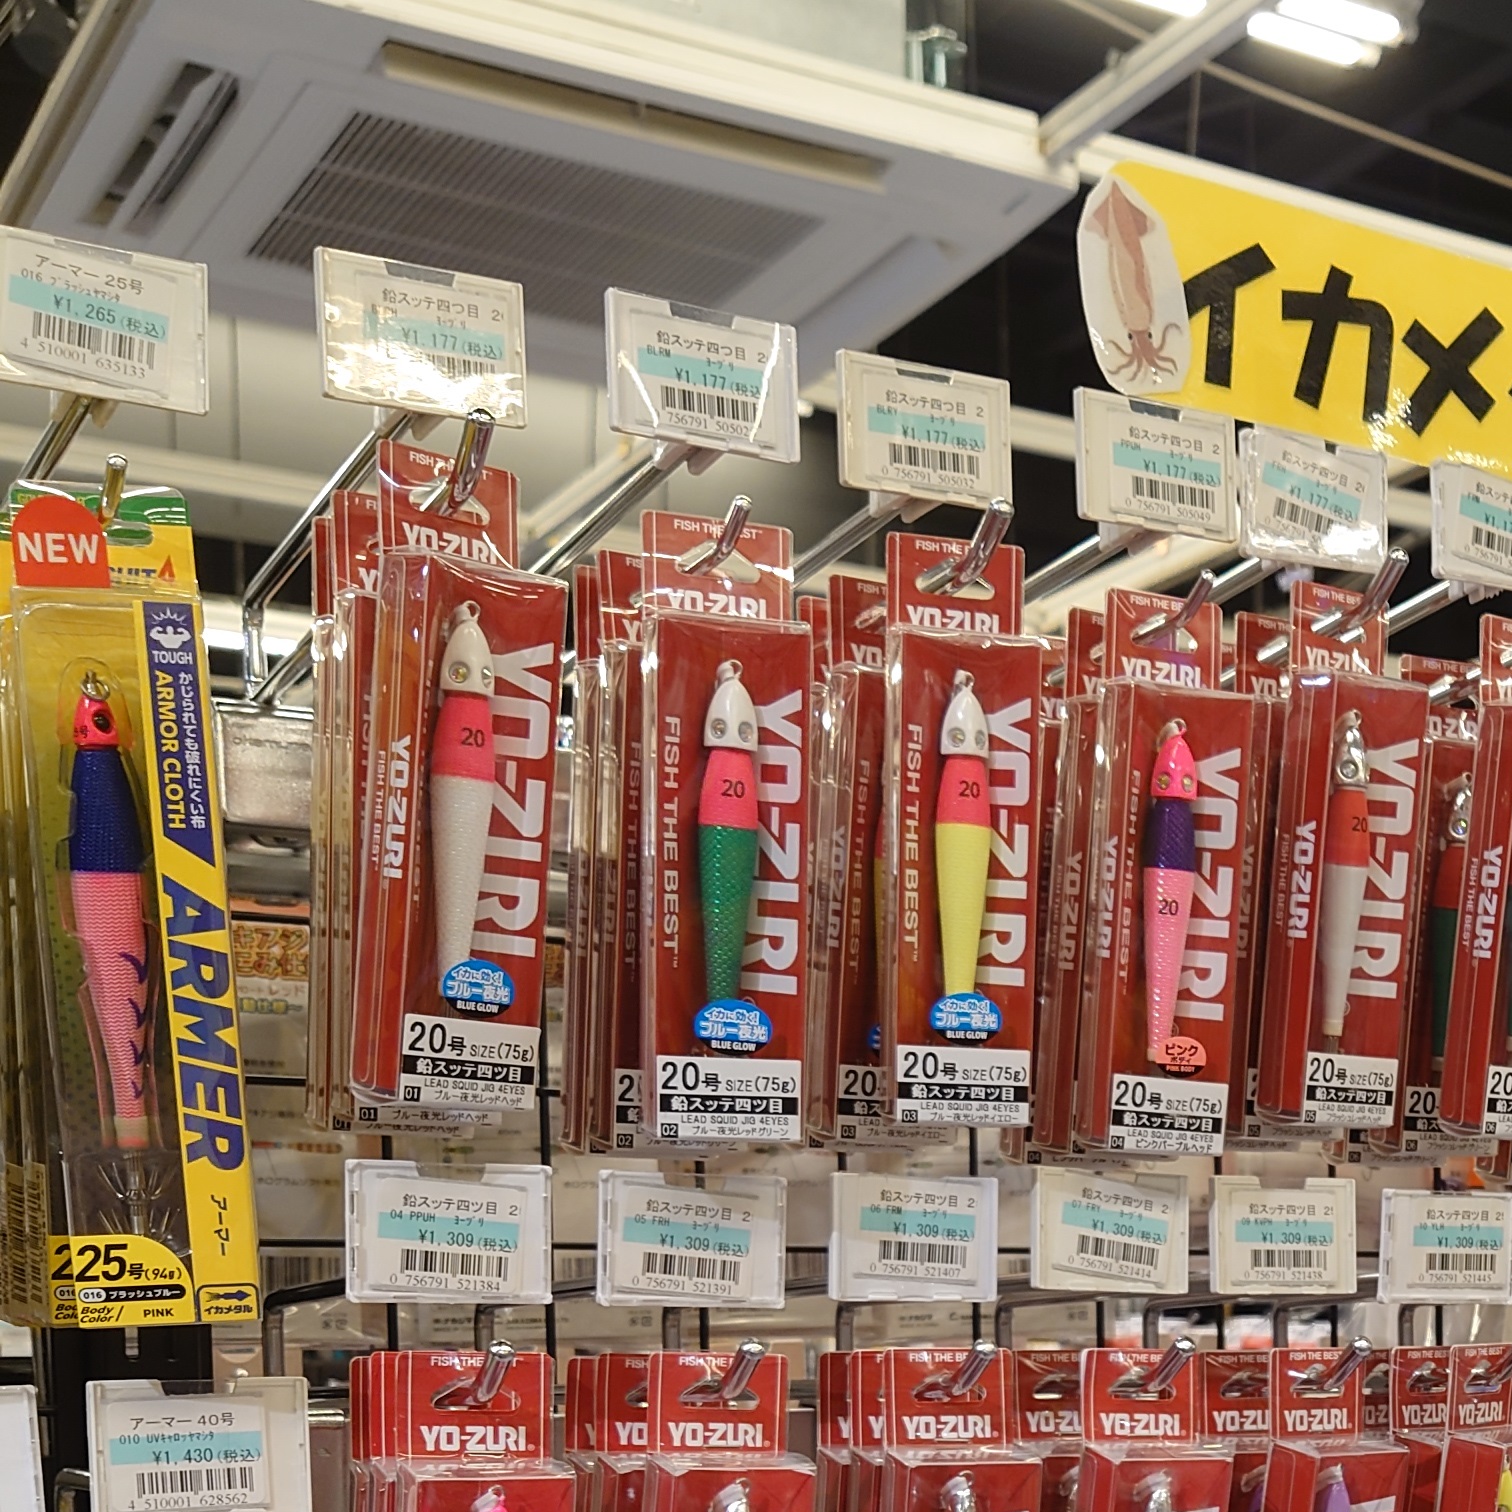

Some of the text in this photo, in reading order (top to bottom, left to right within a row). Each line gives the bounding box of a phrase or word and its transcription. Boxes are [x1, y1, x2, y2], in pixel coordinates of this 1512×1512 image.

[34, 252, 144, 296] アーマー 25号
[381, 287, 480, 320] 鉛スッテ四つ目
[20, 338, 147, 379] 4 510001 635133
[885, 389, 967, 416] 鉛スッテ四つ目
[1128, 425, 1204, 454] 鉛スッテ四つ目
[894, 467, 976, 490] 756791 505032
[1136, 498, 1212, 522] 756791 505049
[18, 532, 100, 565] NEW
[152, 649, 193, 666] TOUGH
[460, 727, 486, 747] 20
[154, 669, 189, 830] ARMOR CLOTH
[177, 670, 208, 830] かじられても破れにくい布
[721, 779, 745, 799] 20
[959, 779, 980, 798] 20
[382, 735, 413, 880] YO-ZURI
[663, 716, 681, 956] FISH THE BEST
[1287, 820, 1318, 940] YO-ZURI
[1157, 899, 1179, 917] 20
[444, 980, 511, 1002] ブルー夜光
[456, 1000, 499, 1014] BLUE GLOW
[159, 876, 247, 1171] ARMER
[700, 1021, 767, 1043] ブルー夜光
[408, 1020, 466, 1056] 20号
[710, 1040, 757, 1052] BLUE GLOW
[1163, 1043, 1200, 1059] ピンク
[415, 1059, 522, 1082] 鉛スッテ四ツ目
[660, 1060, 721, 1093] 20号
[903, 1051, 956, 1081] 20号
[405, 1088, 420, 1100] 01
[424, 1078, 526, 1096] LEAD SQUID JIG 4EYES
[910, 1083, 1015, 1102] 鉛スッテ四ツ目
[1113, 1080, 1162, 1109] 20号
[670, 1094, 784, 1114] 鉛スッテ四ツ目
[662, 1124, 677, 1137] 02
[680, 1114, 790, 1127] LEAD SQUID JIG 4EYES
[1122, 1110, 1213, 1133] 鉛スッテ四ツ目
[403, 1193, 499, 1218] 鉛スッテ四ツ目
[646, 1197, 737, 1222] 鉛スッテ四ツ目
[210, 1193, 230, 1257] アーマー
[390, 1210, 436, 1224] 04 PPUH
[882, 1262, 961, 1279] 756791 521407
[405, 1273, 501, 1293] 756791 521384
[645, 1275, 733, 1295] 756791 521391
[83, 1290, 103, 1300] 016
[108, 1288, 181, 1301] ブラッシュブルー
[143, 1308, 174, 1318] PINK
[203, 1303, 253, 1315] イカメタル
[129, 1411, 235, 1429] アーマー 40号
[903, 1415, 992, 1440] YO-ZURI
[1283, 1407, 1349, 1432] YO-ZURI
[119, 1434, 141, 1446] 010
[420, 1425, 530, 1454] YO-ZURI
[668, 1422, 764, 1448] YO-ZURI
[128, 1493, 248, 1511] 4 510001 628562
